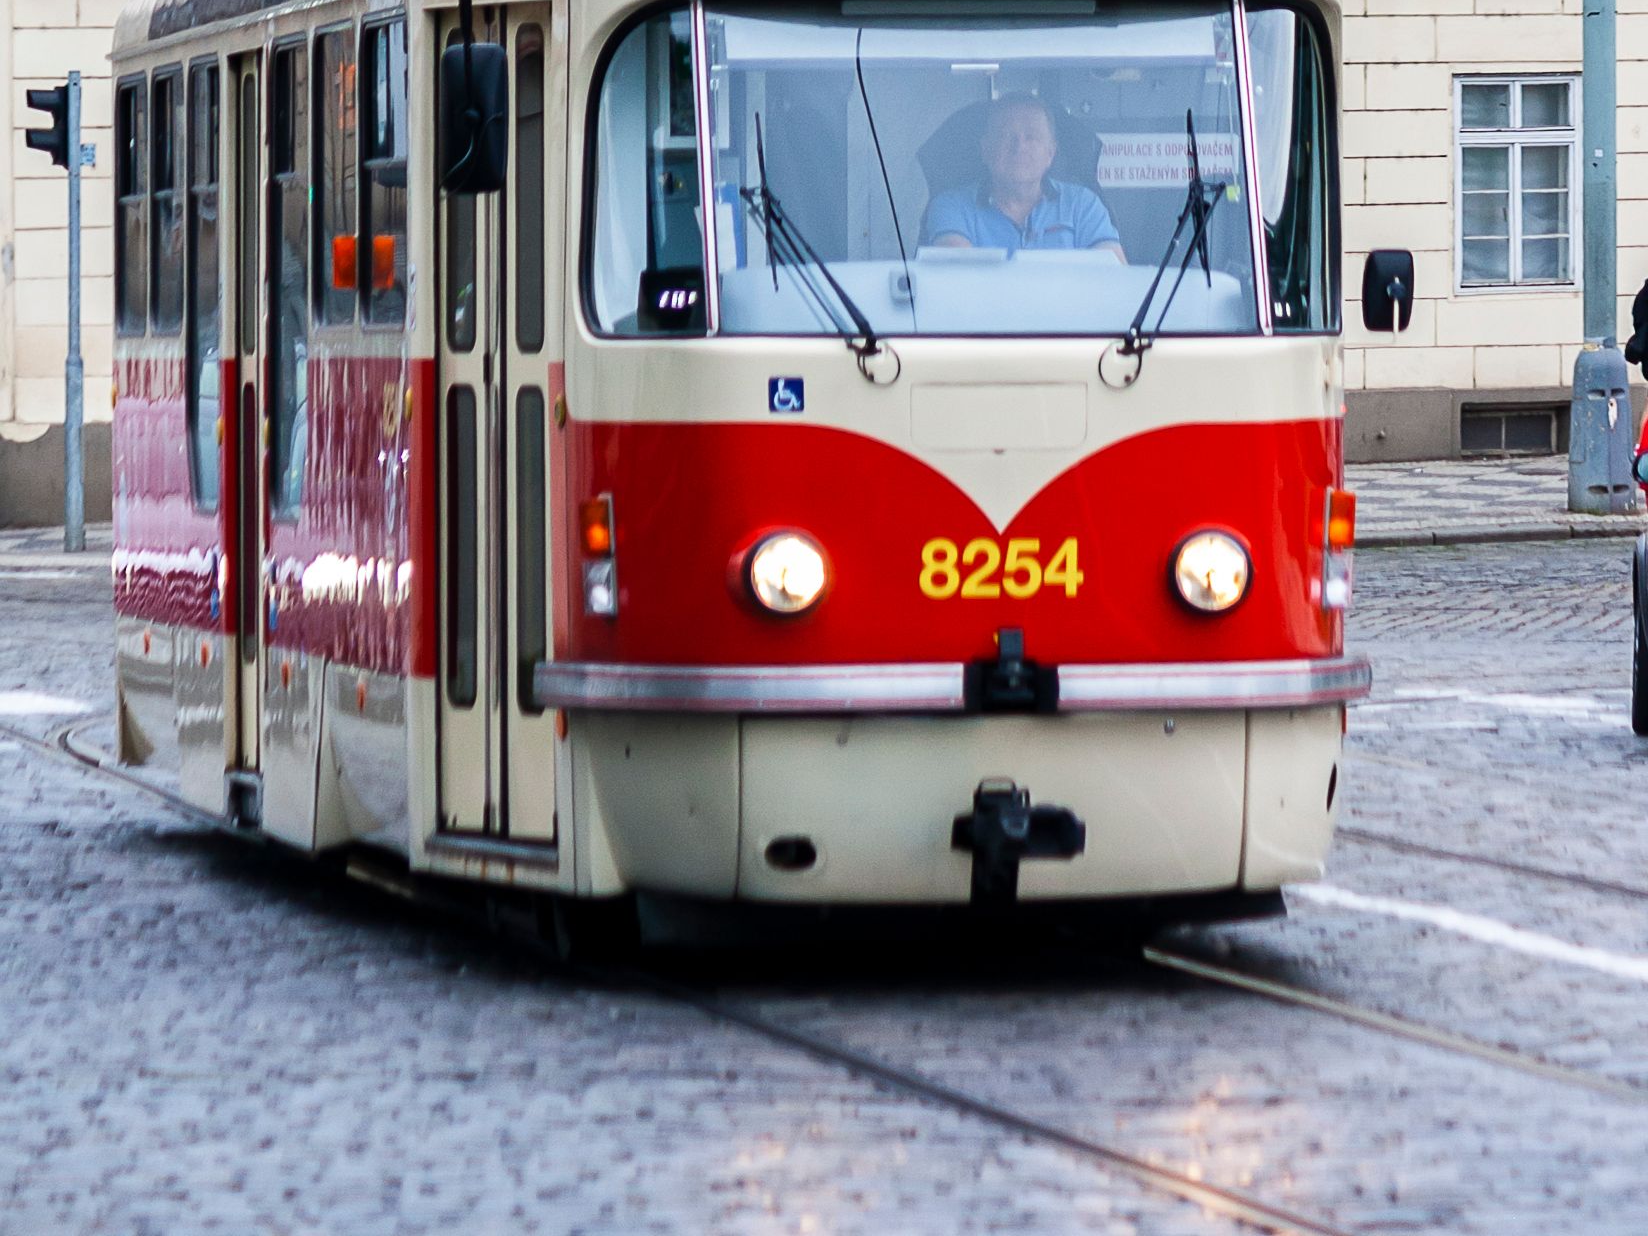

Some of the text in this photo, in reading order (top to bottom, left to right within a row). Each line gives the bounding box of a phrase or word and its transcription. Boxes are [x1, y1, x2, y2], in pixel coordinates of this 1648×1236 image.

[1102, 143, 1153, 156] ANIPULACE
[1099, 167, 1111, 180] EN
[919, 536, 1084, 599] 8254
